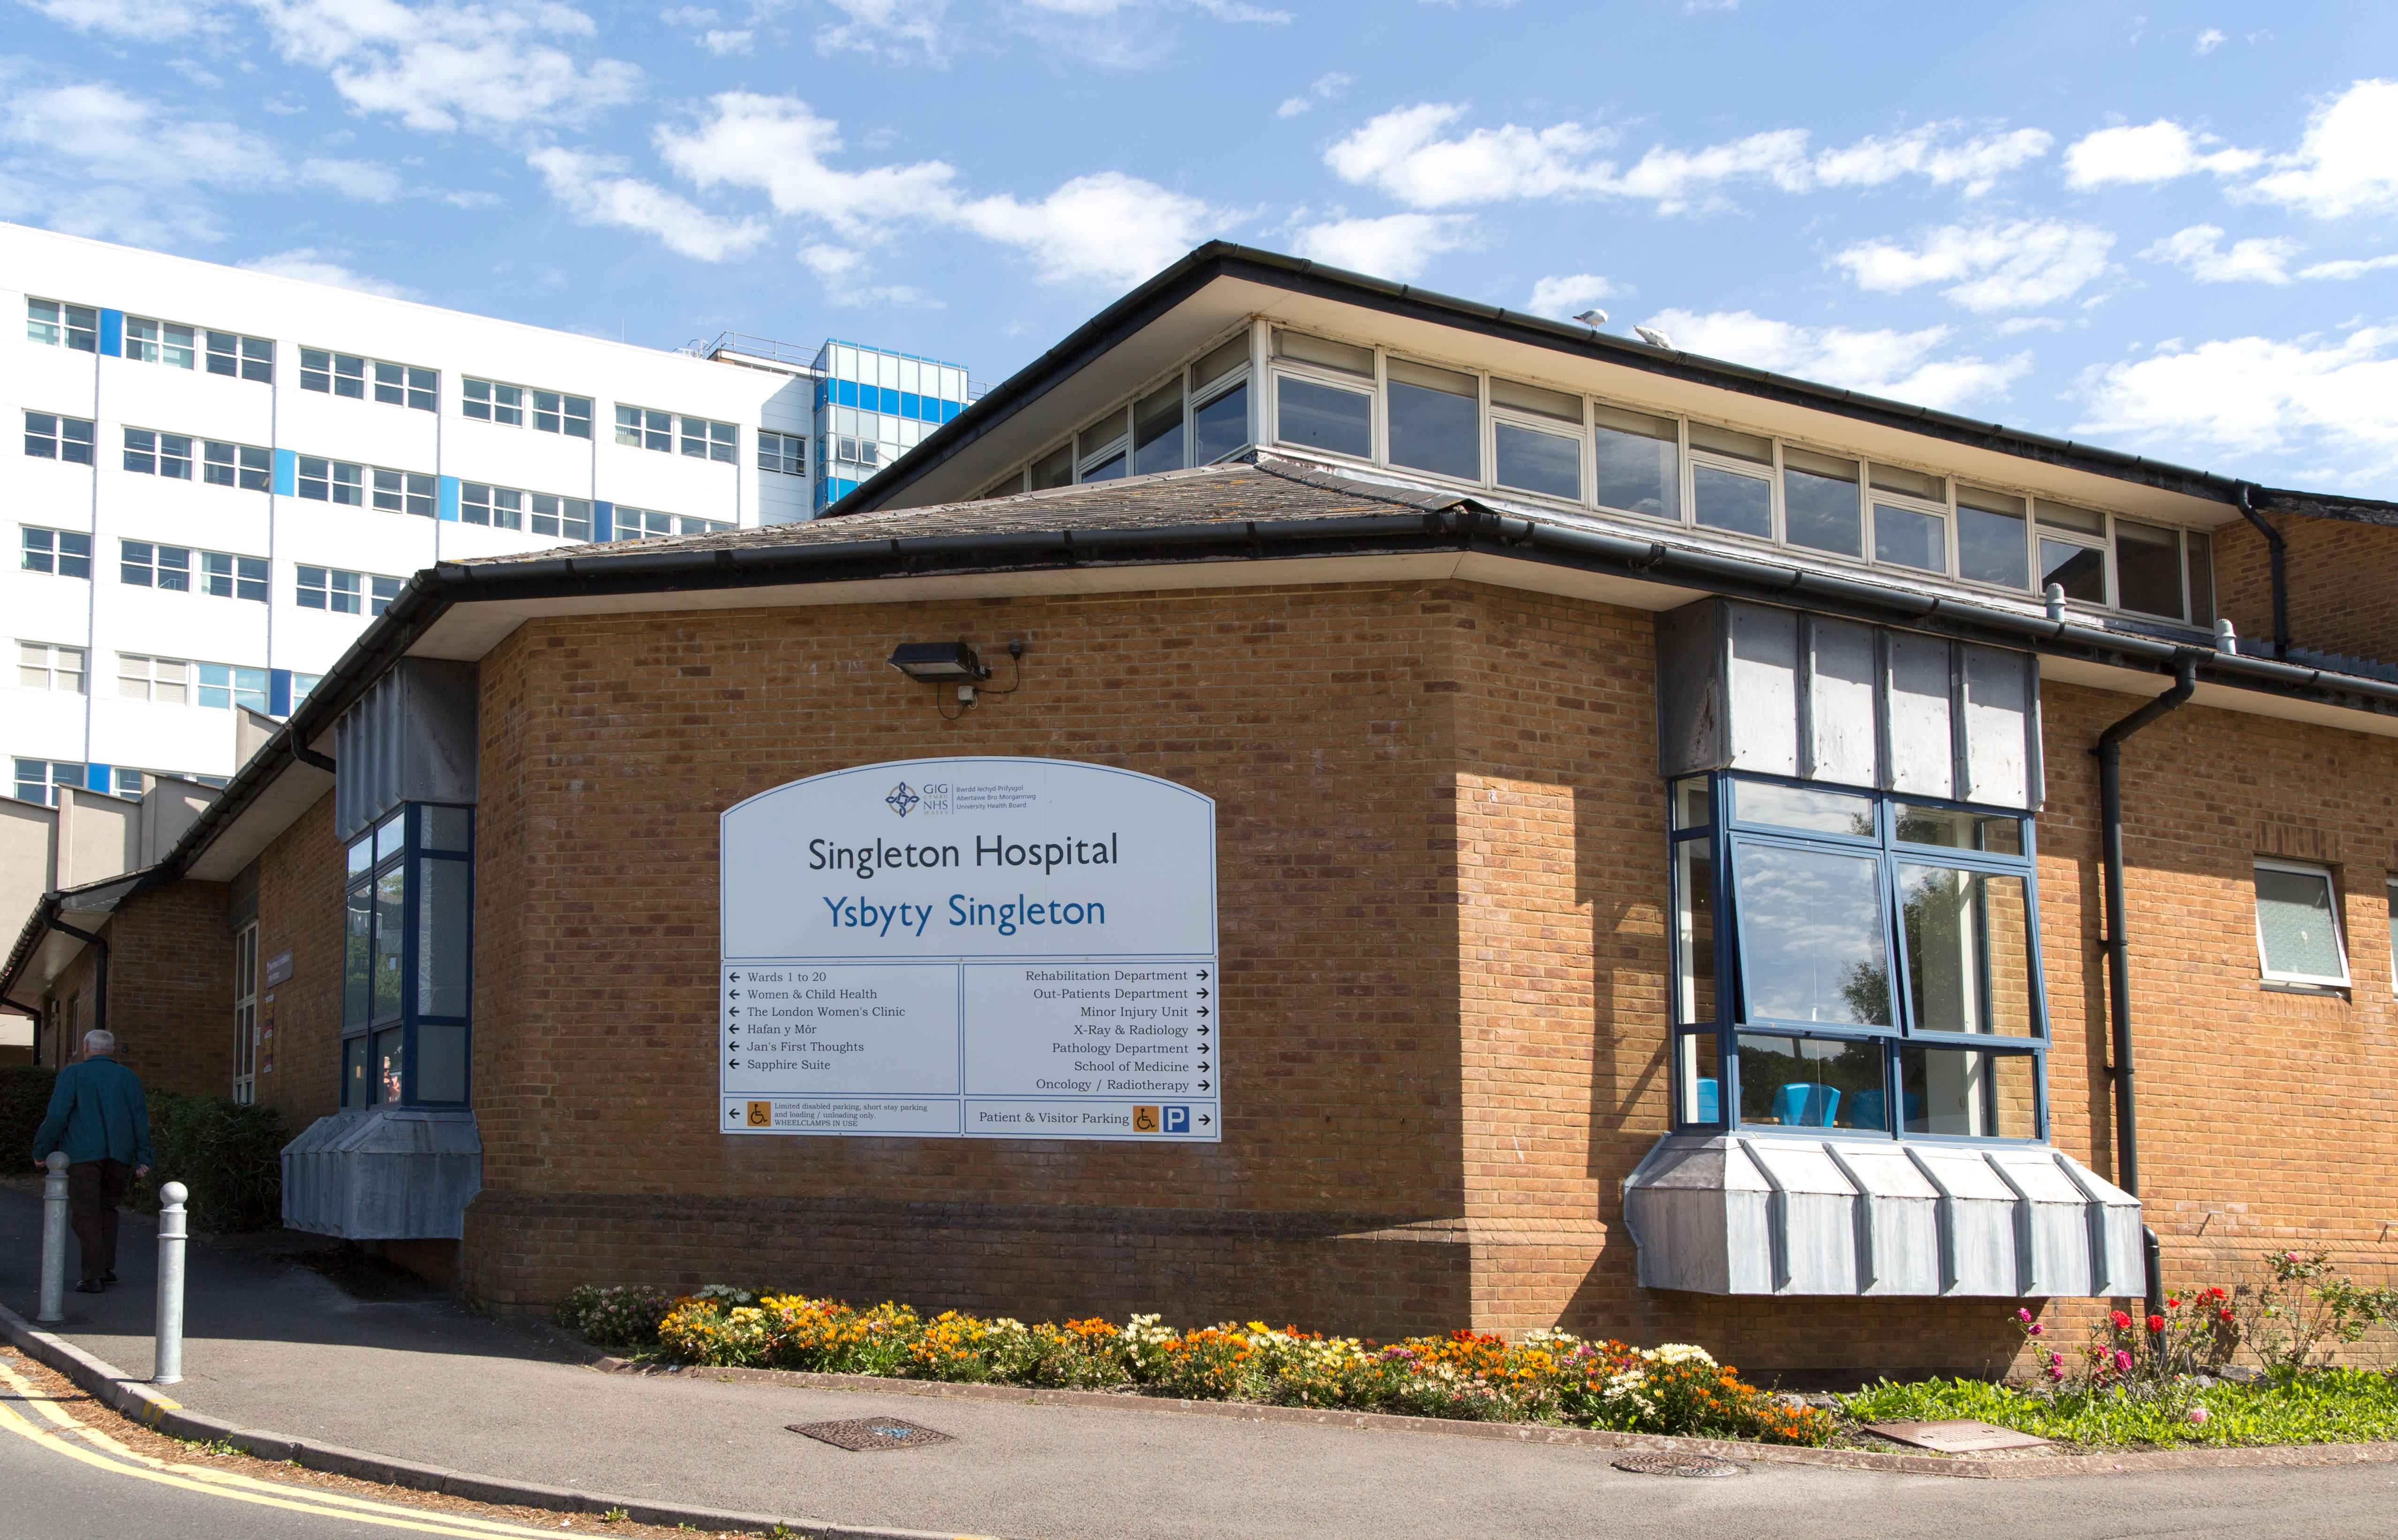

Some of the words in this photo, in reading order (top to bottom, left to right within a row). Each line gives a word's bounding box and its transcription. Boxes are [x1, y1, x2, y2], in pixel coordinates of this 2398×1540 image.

[923, 784, 948, 794] GIG
[924, 800, 948, 810] NHS
[810, 838, 958, 879] Singleton
[977, 833, 1116, 875] Hospital
[823, 896, 933, 937] Ysbyty
[949, 894, 1104, 936] Singleton
[748, 972, 782, 981] Wards
[789, 973, 792, 981] 1
[812, 972, 826, 981] 20
[1026, 971, 1109, 980] Rehabilitation
[1115, 971, 1187, 982] Department
[748, 990, 789, 999] Women
[793, 990, 802, 999] &
[806, 989, 835, 999] Child
[840, 989, 877, 998] Health
[1034, 989, 1110, 998] Out-Patients
[1115, 989, 1188, 1001] Department
[747, 1007, 767, 1016] The
[772, 1007, 813, 1016] London
[818, 1007, 868, 1016] Women's
[873, 1007, 905, 1016] Clinic
[1081, 1007, 1116, 1016] Minor
[1121, 1007, 1157, 1019] Injury
[1162, 1007, 1188, 1016] Unit
[748, 1024, 781, 1033] Hafan
[784, 1027, 790, 1036] y
[795, 1024, 817, 1033] Môr
[1074, 1025, 1111, 1037] X-Ray
[1116, 1025, 1125, 1034] &
[1130, 1025, 1188, 1037] Radiology
[747, 1042, 776, 1051] Jan's
[781, 1042, 806, 1051] First
[810, 1042, 864, 1054] Thoughts
[1053, 1043, 1111, 1055] Pathology
[1116, 1044, 1188, 1055] Department
[748, 1060, 797, 1071] Sapphire
[802, 1060, 830, 1069] Suite
[1075, 1061, 1114, 1071] School
[1119, 1062, 1131, 1071] of
[1134, 1062, 1188, 1071] Medicine
[1037, 1079, 1091, 1092] Oncology
[1097, 1079, 1101, 1092] /
[1108, 1080, 1189, 1092] Radiotherapy
[980, 1112, 1020, 1122] Patient
[1025, 1113, 1035, 1122] &
[1039, 1113, 1078, 1123] Visitor
[1083, 1114, 1129, 1126] Parking
